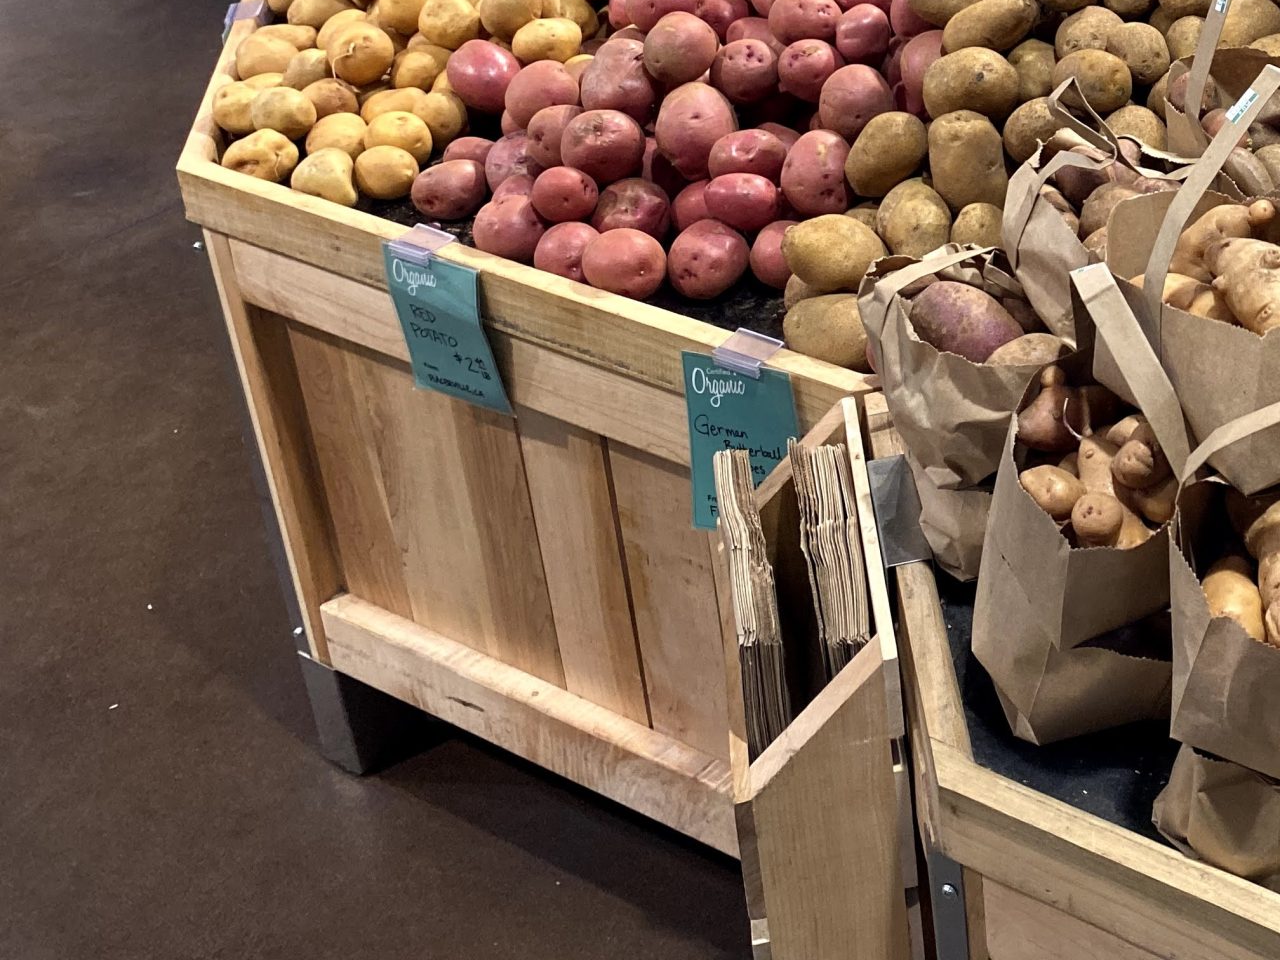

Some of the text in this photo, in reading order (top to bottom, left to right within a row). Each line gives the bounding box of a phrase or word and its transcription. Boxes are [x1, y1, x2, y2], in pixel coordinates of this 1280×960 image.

[392, 258, 436, 296] Organic
[409, 303, 436, 323] RED
[409, 322, 458, 348] POTATO
[692, 367, 746, 408] Organic
[694, 414, 748, 440] German
